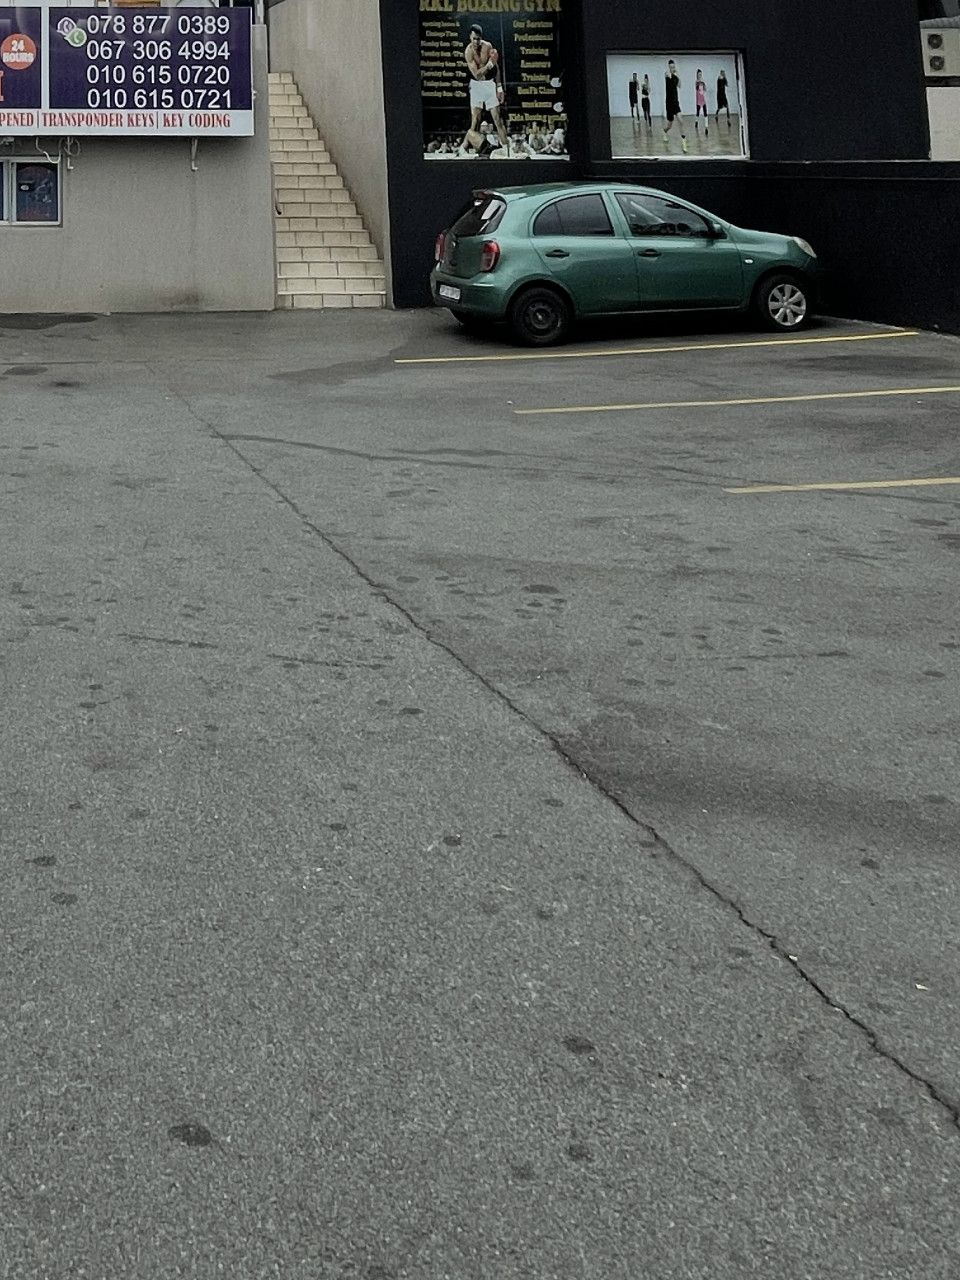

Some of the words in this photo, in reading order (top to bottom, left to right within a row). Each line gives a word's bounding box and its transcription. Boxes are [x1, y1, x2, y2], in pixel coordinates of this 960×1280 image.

[86, 15, 126, 35] 078
[132, 15, 171, 35] 877
[177, 15, 230, 35] 0389
[11, 39, 26, 52] 24
[86, 40, 126, 60] 067
[132, 40, 172, 60] 306
[177, 40, 230, 60] 4994
[86, 65, 126, 84] 010
[132, 65, 172, 84] 615
[177, 65, 230, 84] 0720
[87, 89, 127, 108] 010
[133, 89, 174, 108] 615
[180, 89, 231, 108] 0721
[42, 113, 123, 128] TRANSPONDER
[127, 113, 155, 128] KEYS
[162, 113, 186, 128] KEY
[188, 113, 231, 128] CODING
